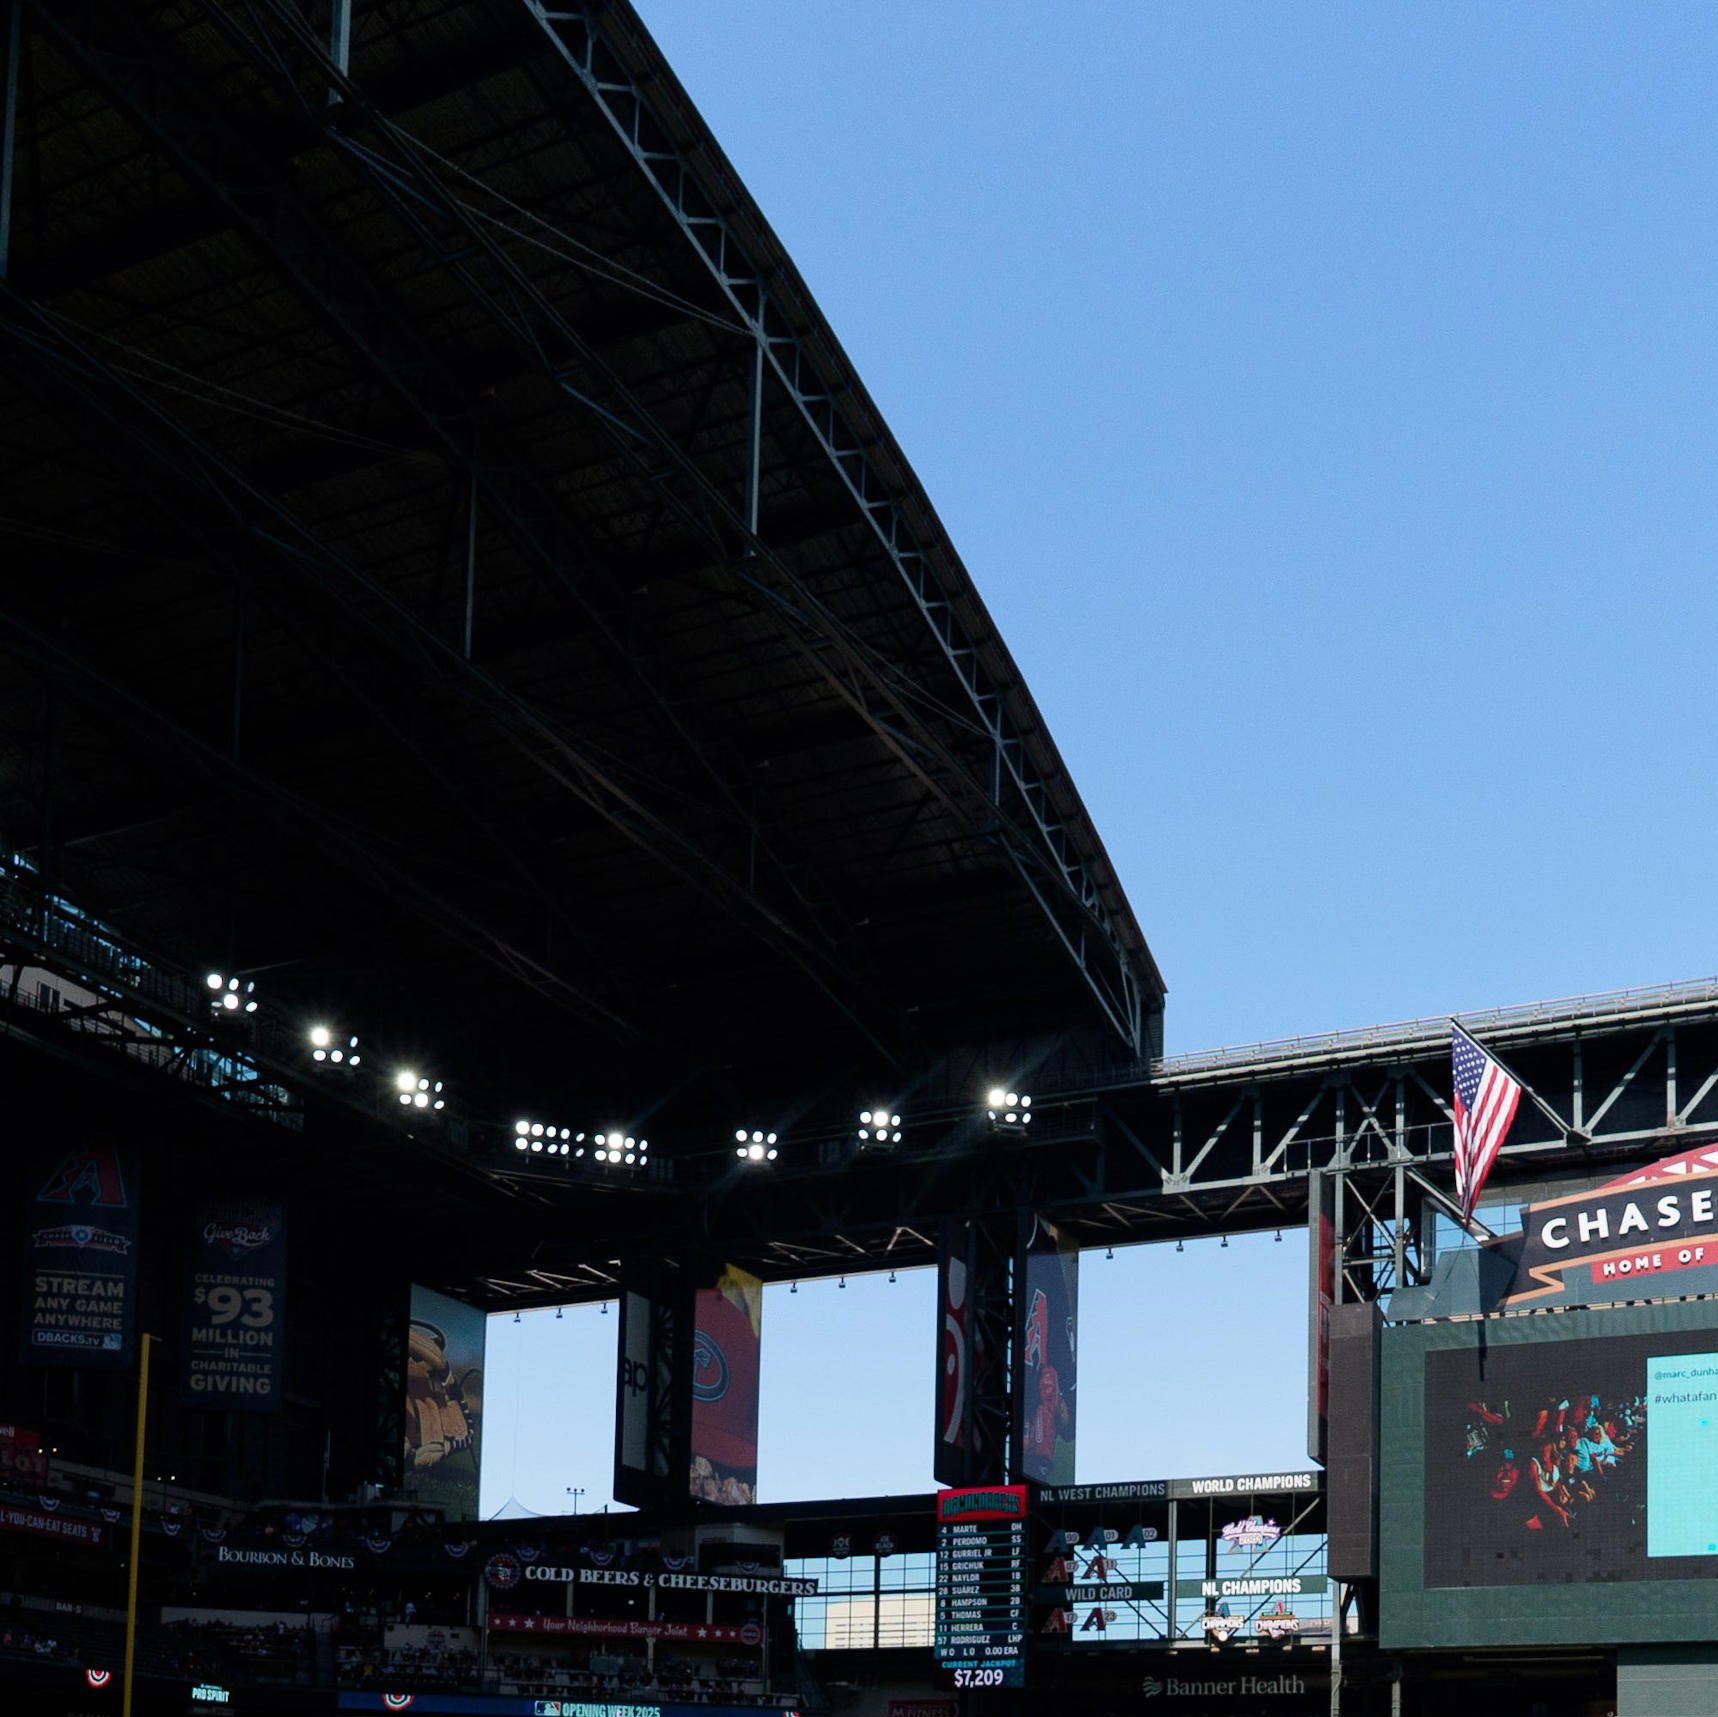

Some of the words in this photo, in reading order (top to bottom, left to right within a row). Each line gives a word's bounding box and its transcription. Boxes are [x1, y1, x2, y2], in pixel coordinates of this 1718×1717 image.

[1541, 1190, 1713, 1250] CHASE
[1603, 1253, 1663, 1276] HOME
[1678, 1247, 1704, 1265] OF
[34, 1277, 124, 1298] STREAM
[194, 1273, 275, 1287] CELEBRATING
[34, 1297, 68, 1312] ANY
[76, 1299, 122, 1314] GAME
[194, 1287, 274, 1328] $93
[33, 1314, 122, 1330] ANYWHERE
[192, 1328, 272, 1346] MILLION
[224, 1347, 239, 1359] IN
[191, 1360, 272, 1374] CHARITABLE
[190, 1374, 271, 1394] GIVING
[1655, 1391, 1717, 1404] #whatafan
[1041, 1490, 1055, 1501] NL
[1059, 1488, 1091, 1499] WEST
[1095, 1483, 1165, 1498] CHAMPIONS
[1193, 1480, 1233, 1493] WORLD
[1237, 1475, 1311, 1491] CHAMPIONS
[62, 1521, 86, 1537] SEATS
[953, 1525, 977, 1533] MARTE
[953, 1537, 987, 1545] PERDOMO
[219, 1546, 287, 1565] BOURBON
[291, 1551, 304, 1565] &
[309, 1552, 354, 1569] BONES
[940, 1551, 949, 1559] 12
[952, 1562, 984, 1570] GRICHUK
[525, 1566, 574, 1582] COLD
[580, 1568, 639, 1585] BEERS
[643, 1569, 652, 1587] &
[659, 1572, 816, 1596] CHEESEBURGERS
[1202, 1582, 1219, 1596] NL
[1222, 1579, 1301, 1595] CHAMPIONS
[952, 1585, 979, 1594] SUÁREZ
[1066, 1588, 1095, 1600] WILD
[1100, 1586, 1132, 1599] CARD
[951, 1598, 987, 1606] HAMPSON
[951, 1611, 981, 1619] THOMAS
[543, 1617, 564, 1631] Your
[568, 1619, 626, 1634] Neighborhood
[630, 1621, 662, 1637] Burger
[665, 1623, 688, 1637] Joint
[951, 1636, 990, 1644] RODRIGUEZ
[1008, 1635, 1022, 1643] LHP
[985, 1647, 1002, 1655] 0.00
[1004, 1647, 1018, 1655] ERA
[954, 1669, 1003, 1687] $7,209
[1166, 1676, 1236, 1696] Banner
[1241, 1675, 1305, 1695] Health
[192, 1688, 206, 1700] PRO
[207, 1689, 229, 1702] SPIRIT
[562, 1703, 606, 1717] OPENING
